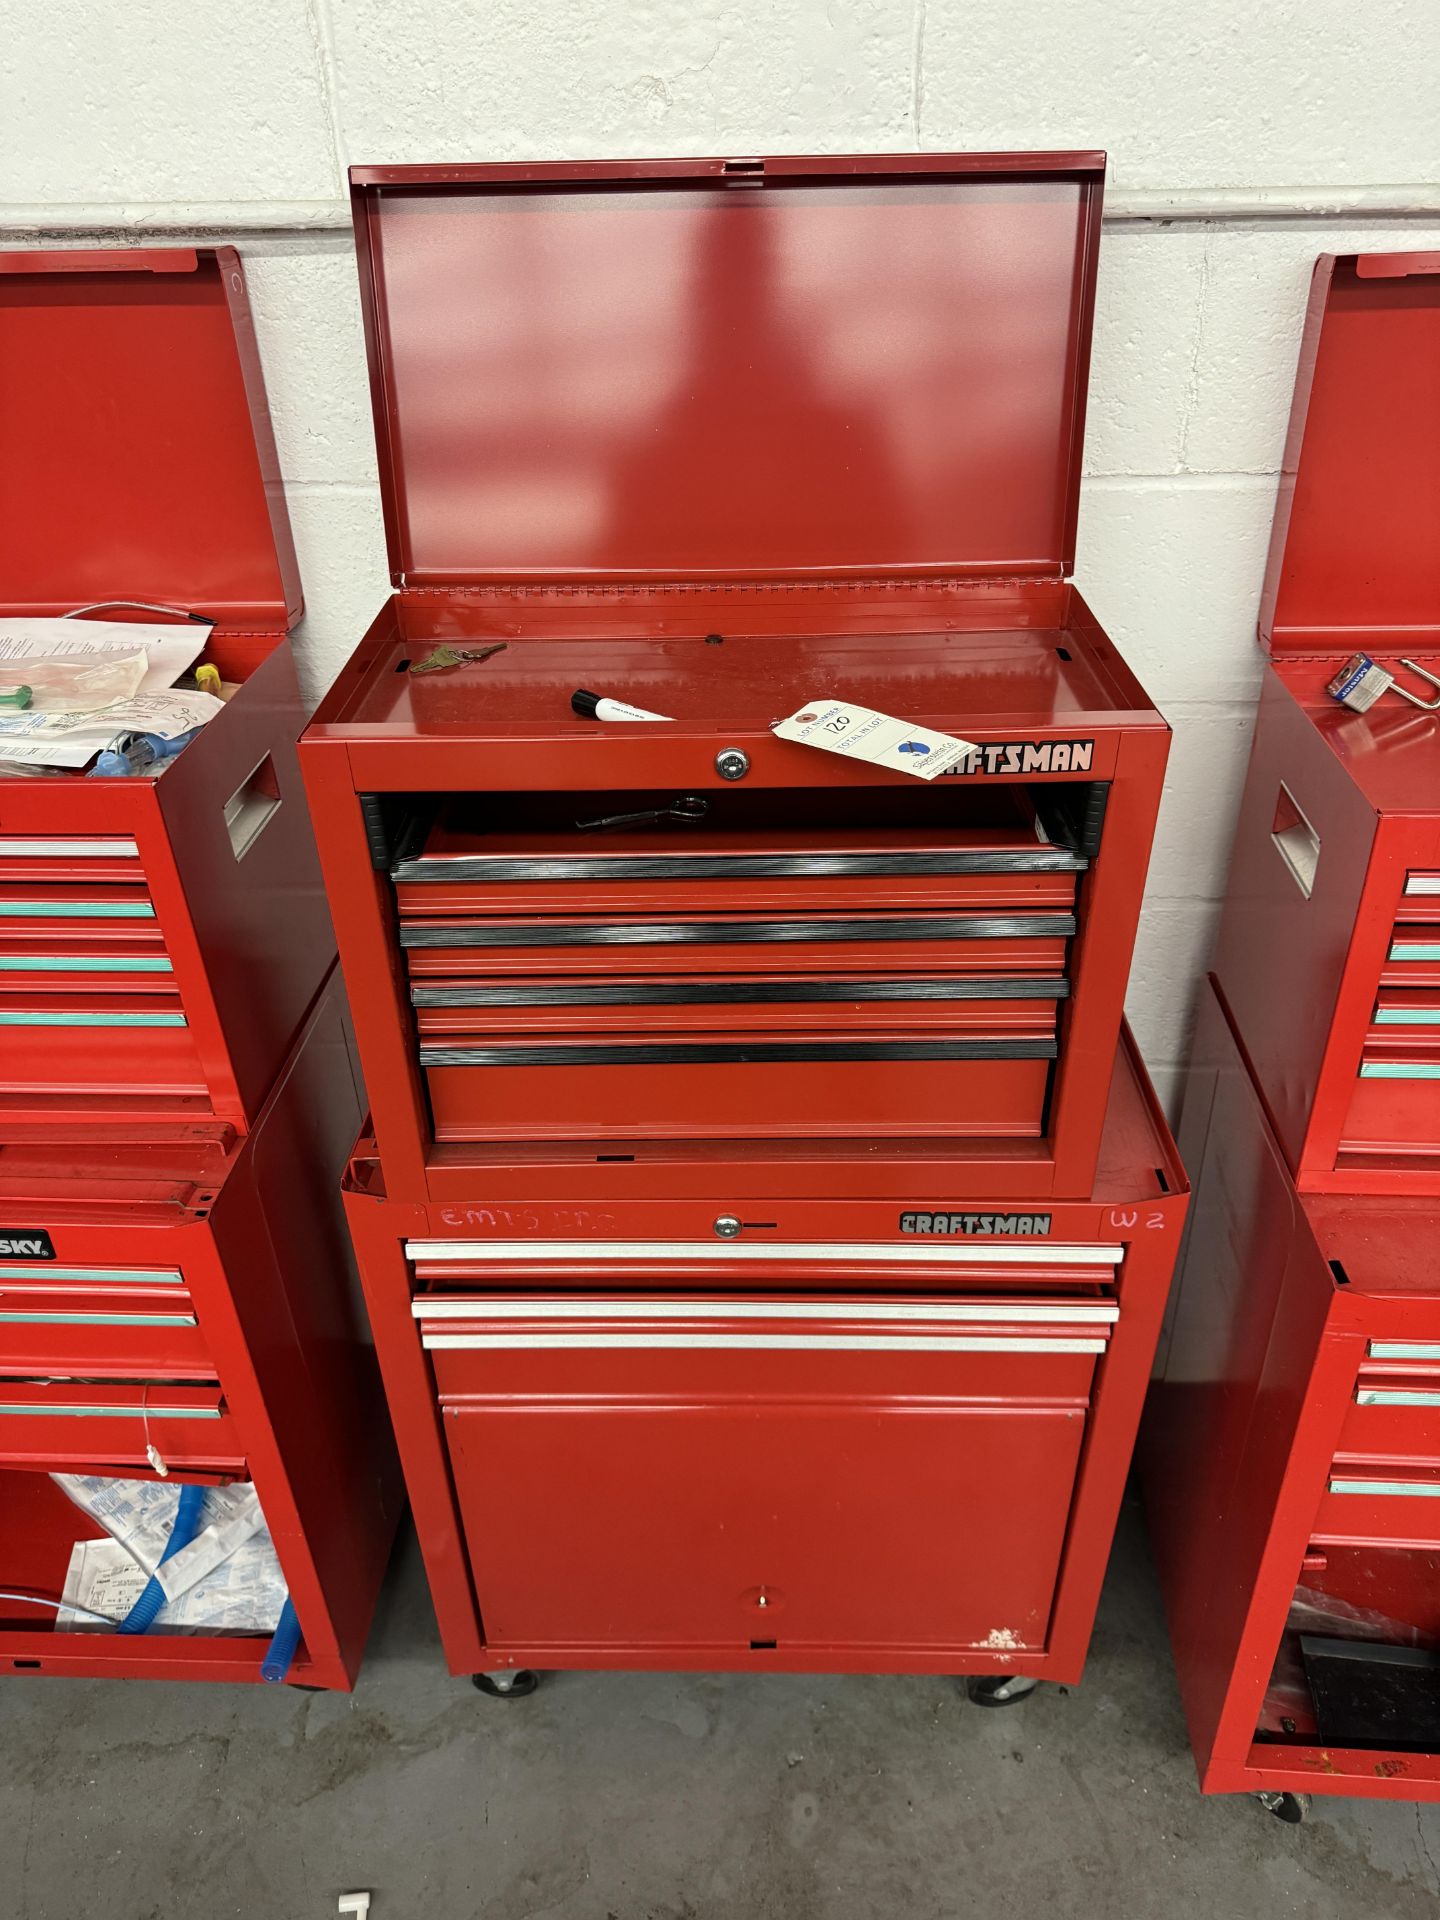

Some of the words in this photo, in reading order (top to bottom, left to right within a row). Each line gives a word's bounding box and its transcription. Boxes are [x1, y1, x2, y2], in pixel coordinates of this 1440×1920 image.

[797, 725, 813, 738] LOT
[812, 706, 839, 726] NUMBER
[823, 716, 850, 735] 120
[837, 734, 861, 750] TOTAL
[867, 716, 883, 729] LOT
[902, 1215, 1051, 1235] CRAFTSMAN
